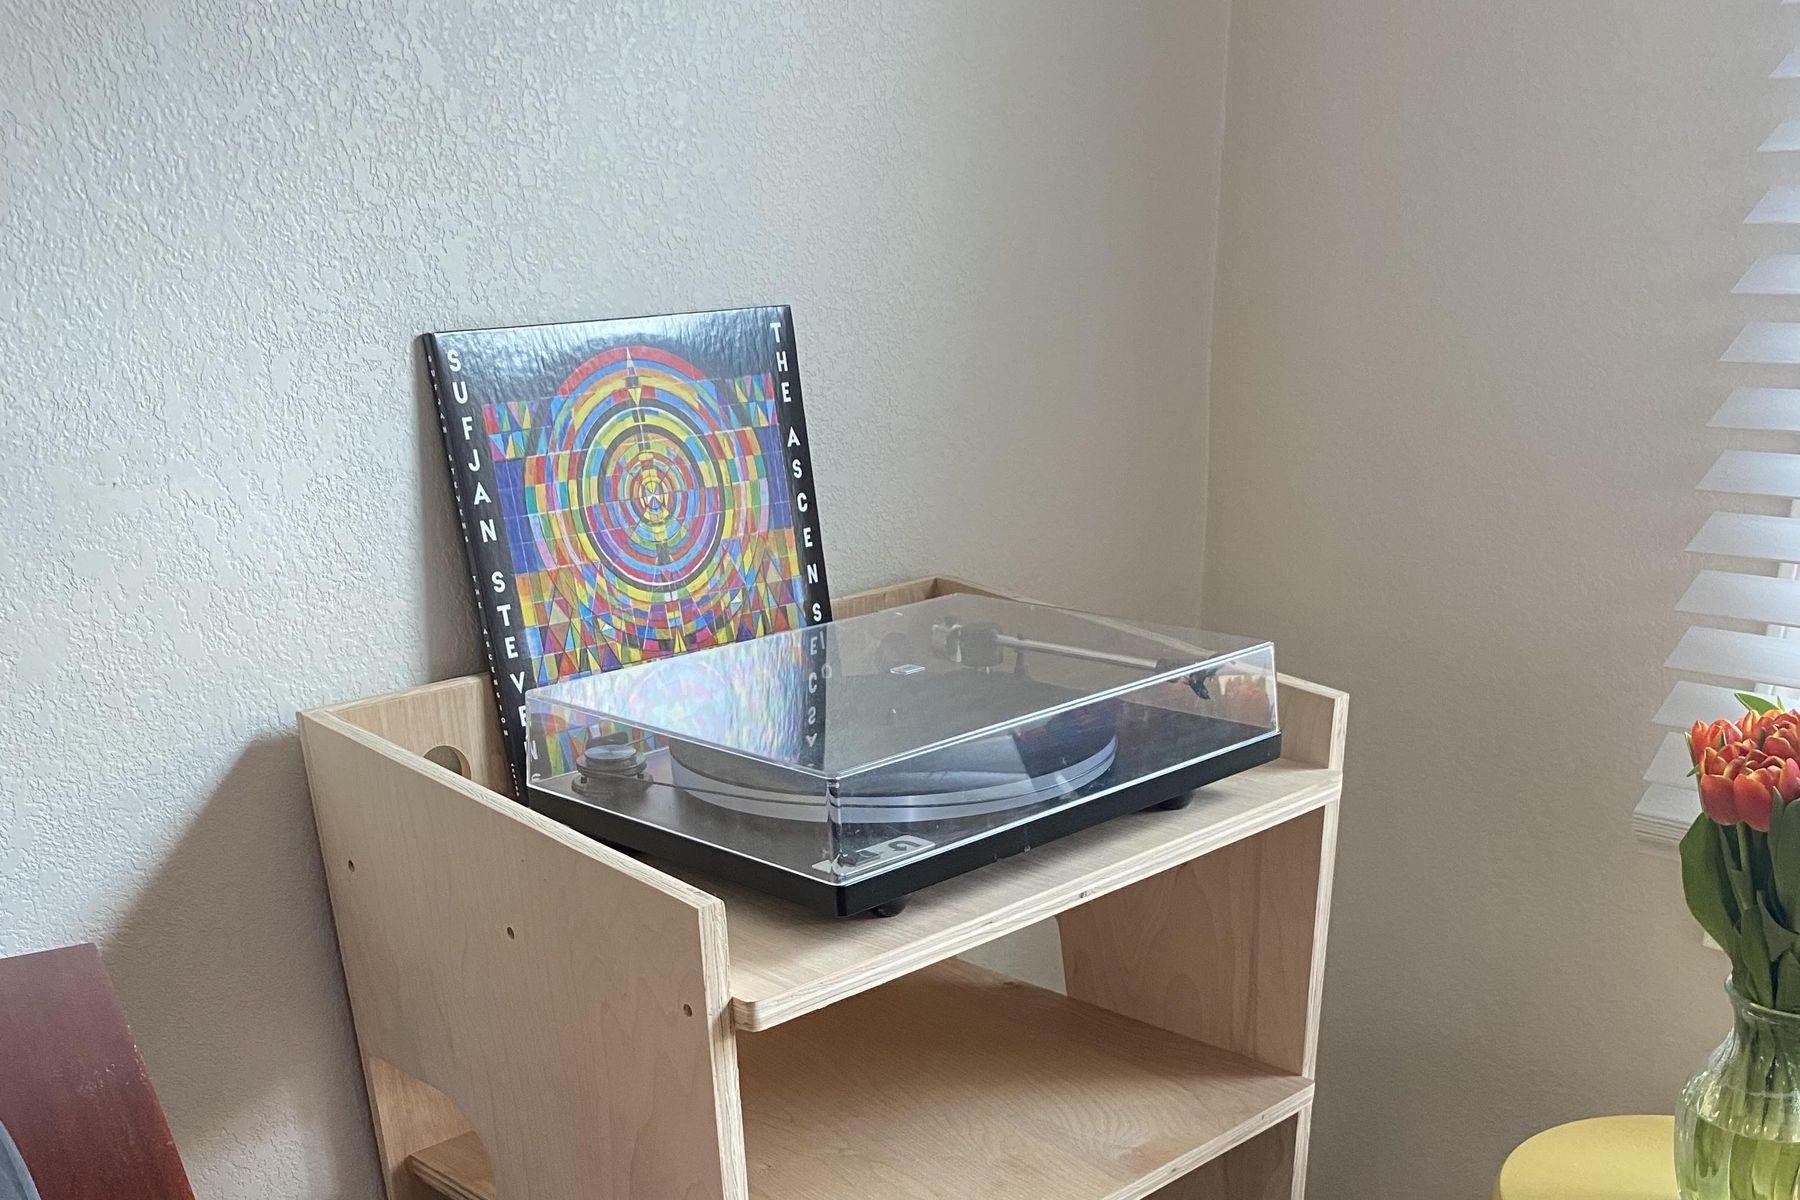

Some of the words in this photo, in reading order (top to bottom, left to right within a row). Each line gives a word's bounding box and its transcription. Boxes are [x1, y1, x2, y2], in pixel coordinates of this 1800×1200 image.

[769, 321, 792, 403] THE
[447, 349, 498, 543] SUFJAN
[483, 628, 509, 737] ASCENSION
